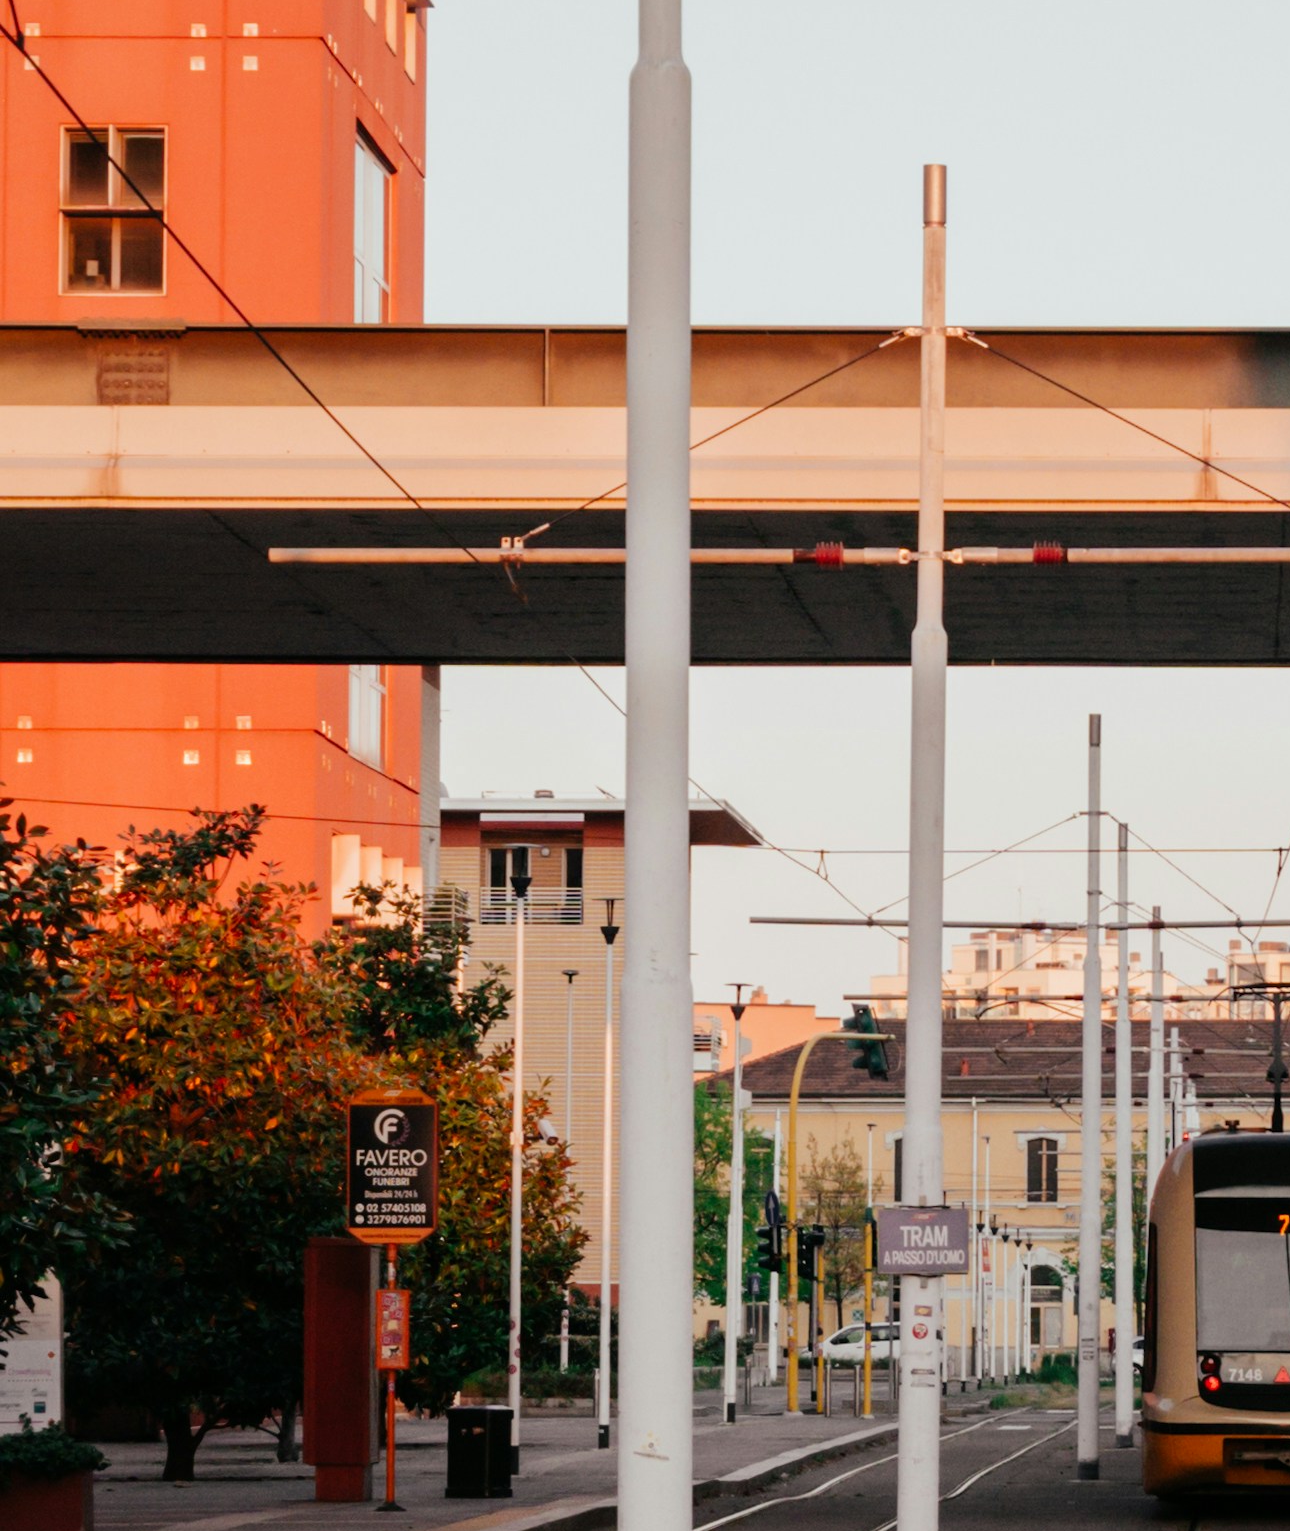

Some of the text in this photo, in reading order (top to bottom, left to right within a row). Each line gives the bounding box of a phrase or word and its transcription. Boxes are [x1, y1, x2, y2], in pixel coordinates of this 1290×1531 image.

[356, 1149, 427, 1166] FAVERO
[364, 1168, 418, 1177] ONORANZE
[372, 1177, 410, 1186] FUNEBRI
[394, 1190, 413, 1199] 24/24
[366, 1203, 426, 1213] 02 57405108
[367, 1214, 426, 1224] 3279876901
[1278, 1214, 1290, 1236] 7
[899, 1225, 948, 1247] TRAM
[883, 1249, 965, 1265] A PASSO D'UOMO
[1228, 1368, 1263, 1382] 7148
